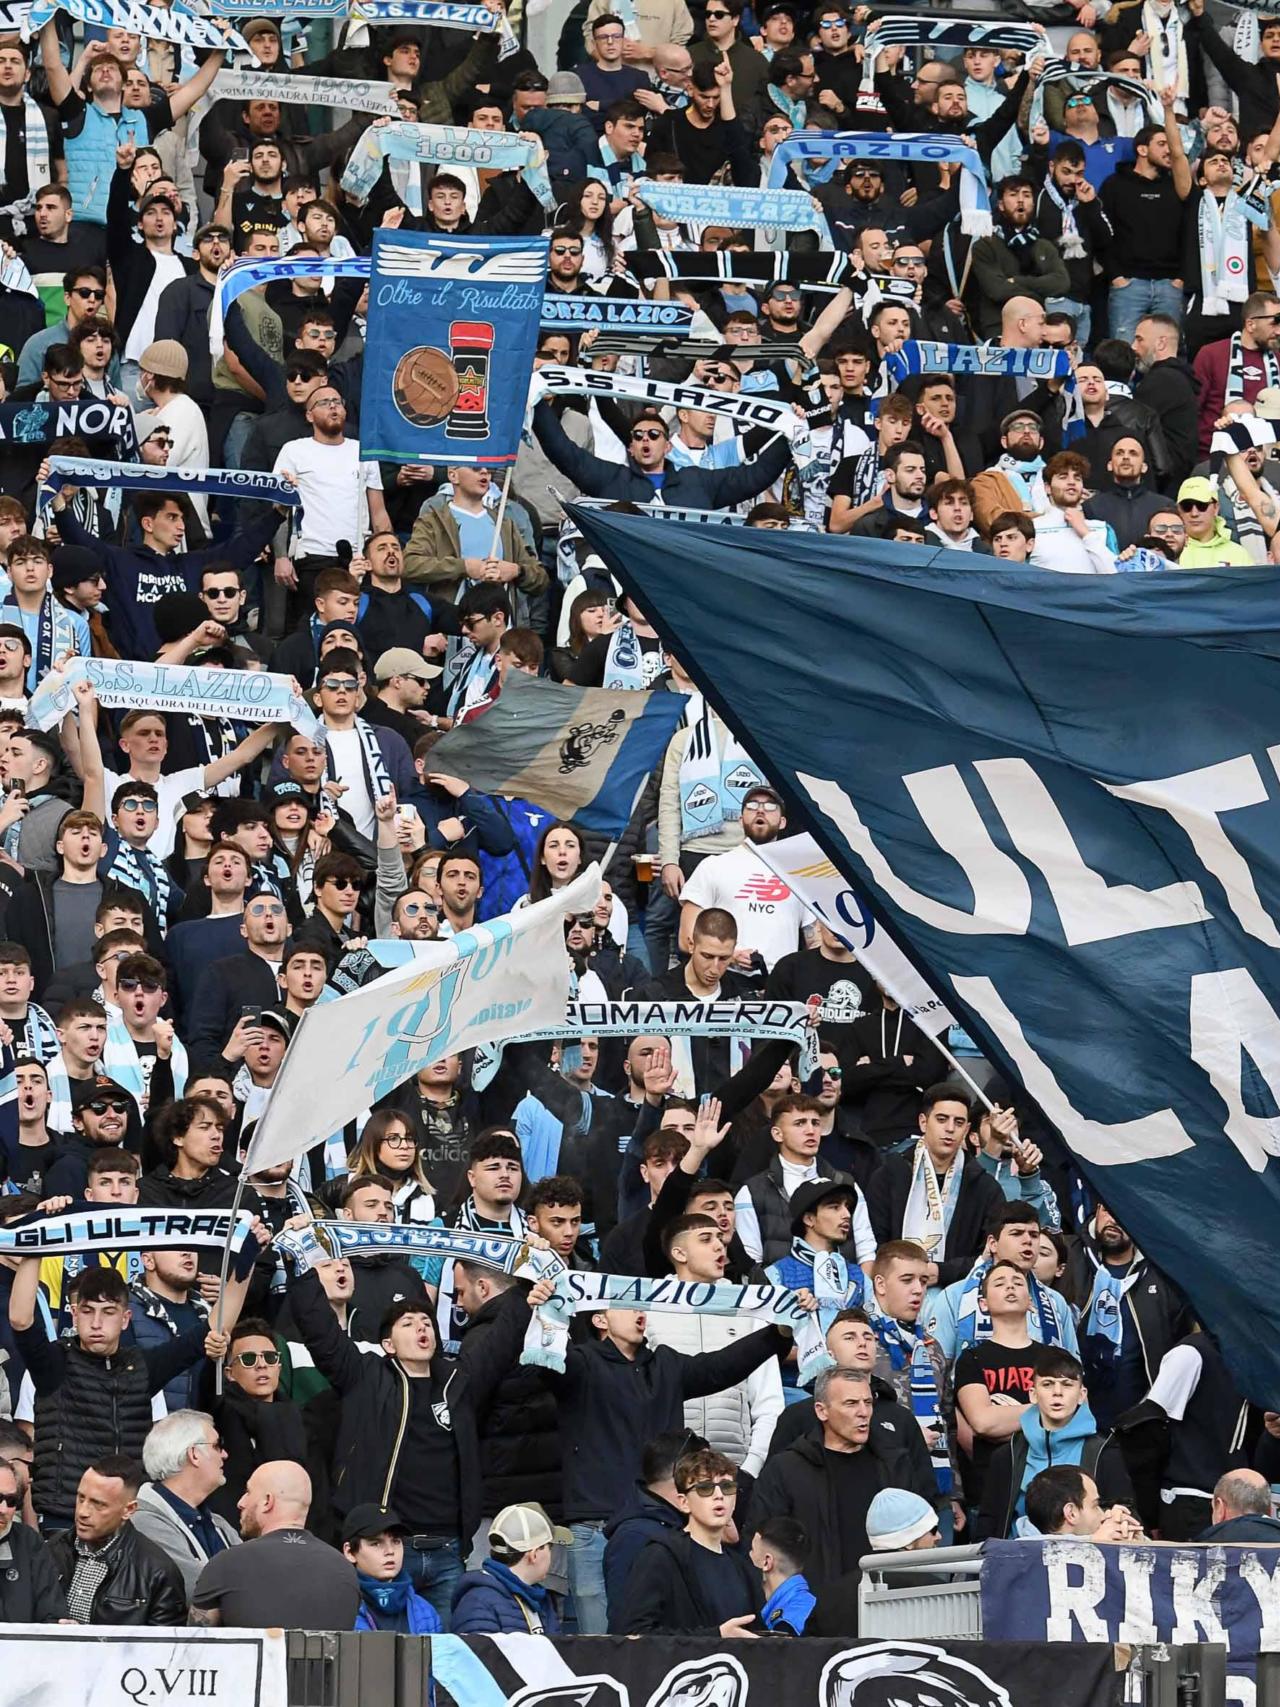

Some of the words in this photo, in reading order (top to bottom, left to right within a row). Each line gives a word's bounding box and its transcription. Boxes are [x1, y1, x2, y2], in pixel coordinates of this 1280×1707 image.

[365, 4, 413, 18] S.S.
[416, 6, 494, 25] LAZIO
[220, 88, 254, 98] PRIMA
[256, 88, 309, 102] SQUADRA
[311, 92, 347, 106] DELLA
[415, 134, 492, 163] 1900
[800, 142, 951, 159] LAZIO
[377, 278, 423, 307] Oltre
[430, 282, 454, 306] il
[457, 283, 540, 314] Risultato
[540, 301, 602, 321] ORZA
[607, 303, 677, 324] LAZIO
[922, 342, 1054, 375] LAZIO
[539, 370, 626, 393] S.S.
[646, 383, 784, 424] LAZIO
[85, 659, 144, 692] S.S.
[151, 665, 273, 704] LAZIO
[94, 692, 127, 705] RIMA
[128, 696, 186, 712] SQUADRA
[187, 702, 224, 714] DELLA
[226, 704, 283, 719] CAPITALE
[748, 902, 775, 915] NYC
[14, 1222, 73, 1247] GLI
[87, 1214, 242, 1240] ULTRAS
[983, 1366, 1035, 1393] DIAB
[120, 1667, 219, 1706] Q.VIII
